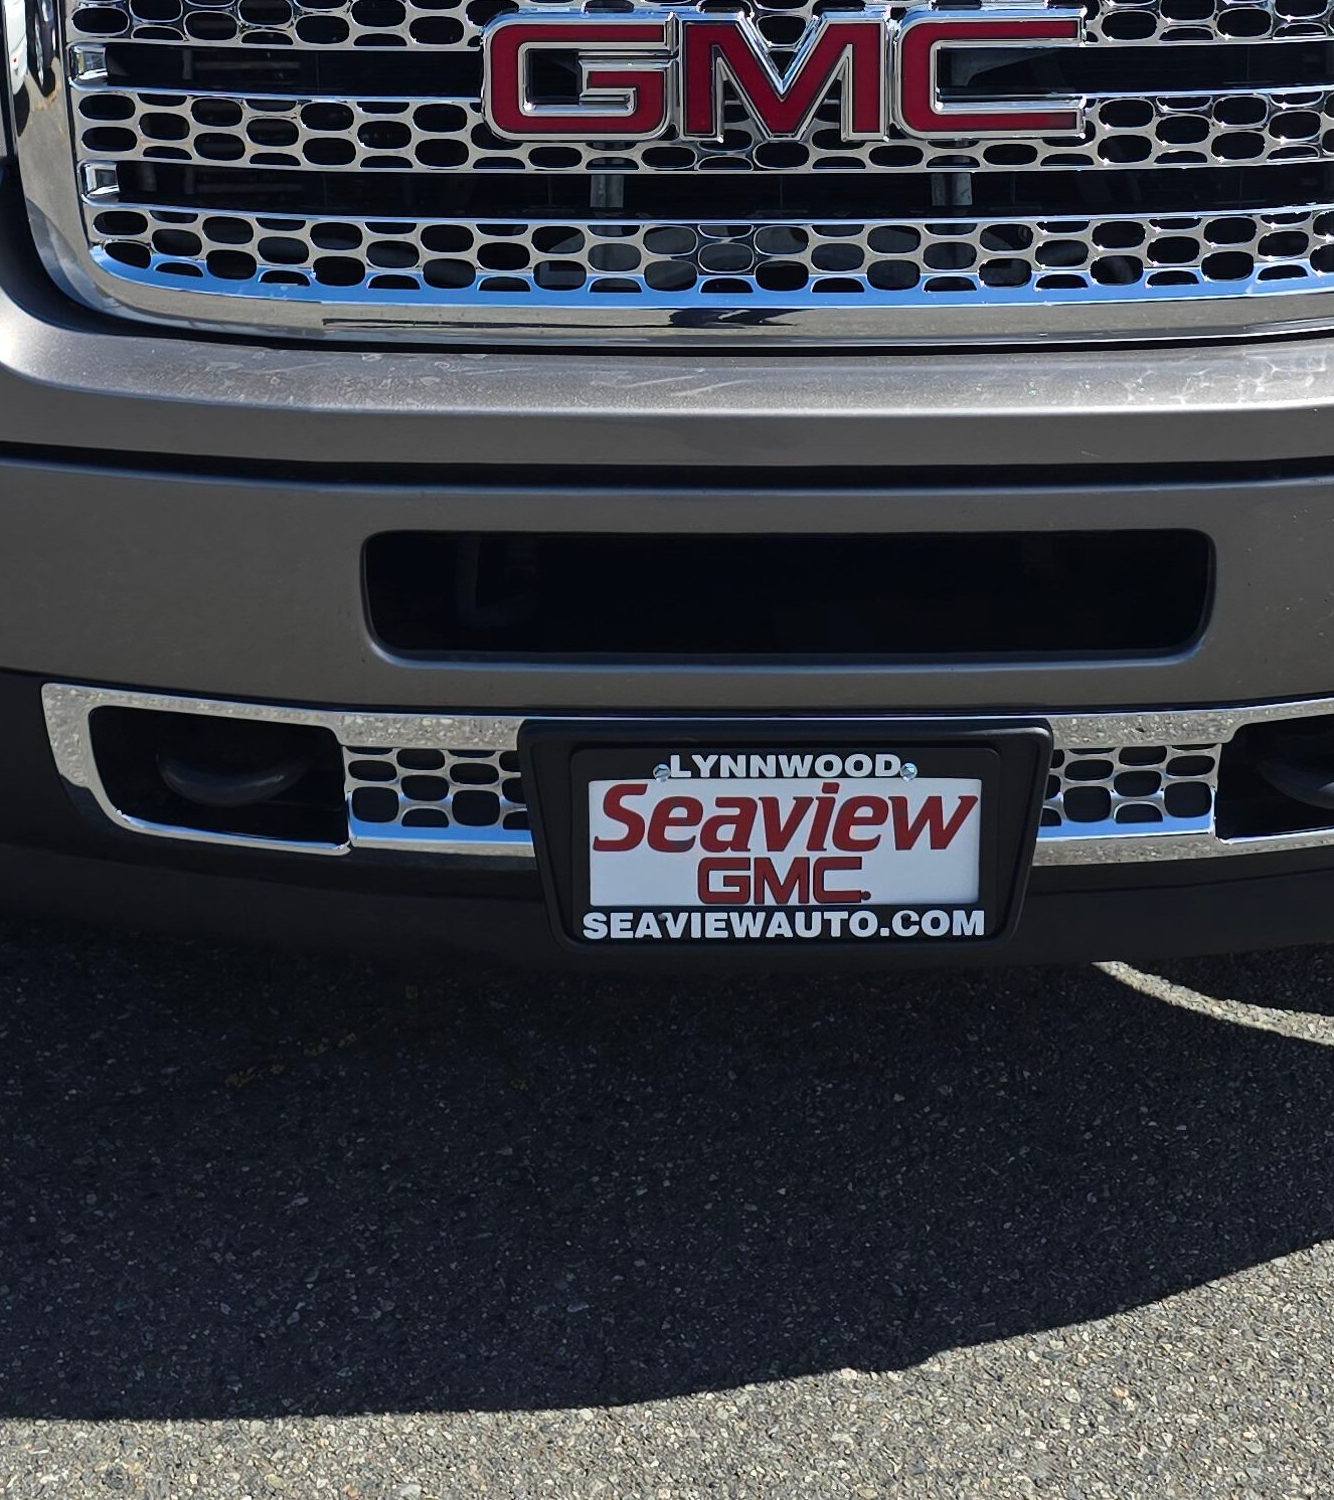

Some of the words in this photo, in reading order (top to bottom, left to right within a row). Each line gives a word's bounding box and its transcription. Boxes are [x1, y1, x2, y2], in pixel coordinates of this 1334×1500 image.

[481, 6, 1087, 143] GMC
[669, 753, 902, 779] LYNNWOOD
[592, 782, 979, 853] Seaview
[582, 910, 985, 940] SEAVIEWAUTO.COM
